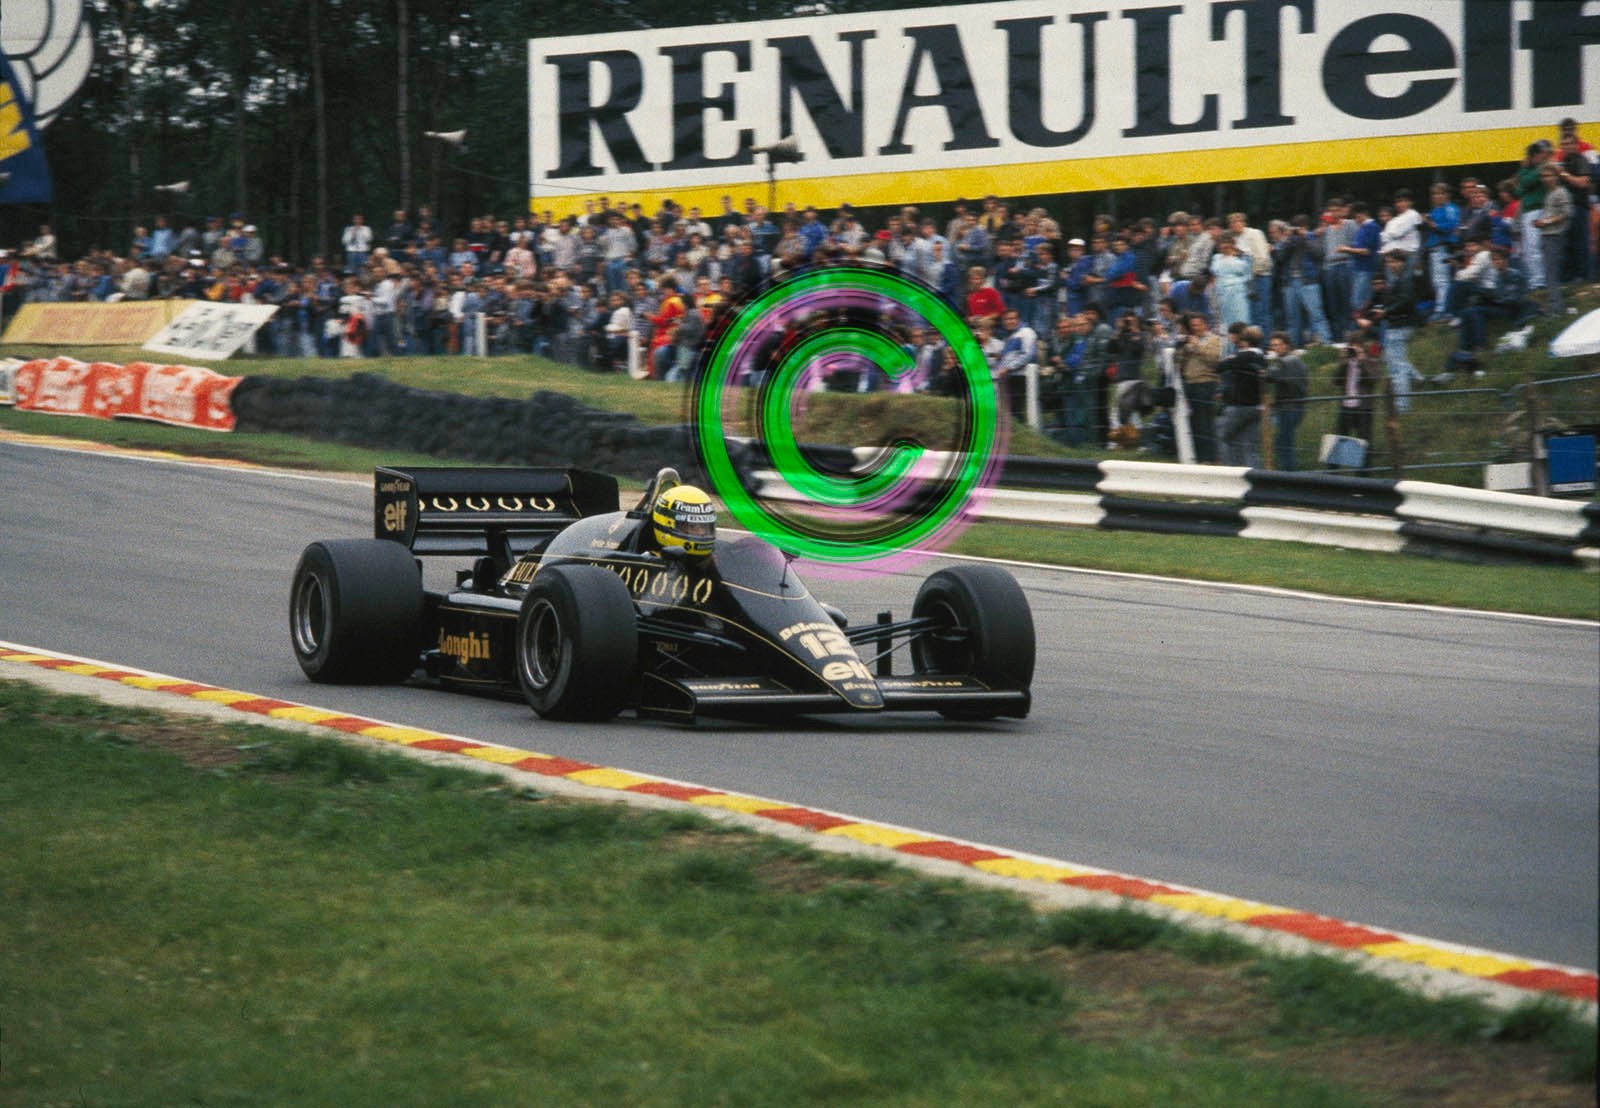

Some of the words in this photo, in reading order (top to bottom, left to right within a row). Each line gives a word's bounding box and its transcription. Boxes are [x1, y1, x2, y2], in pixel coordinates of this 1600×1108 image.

[544, 0, 1316, 179] RENAULT
[1321, 0, 1600, 120] elf
[384, 500, 407, 531] elf
[800, 632, 858, 659] 12
